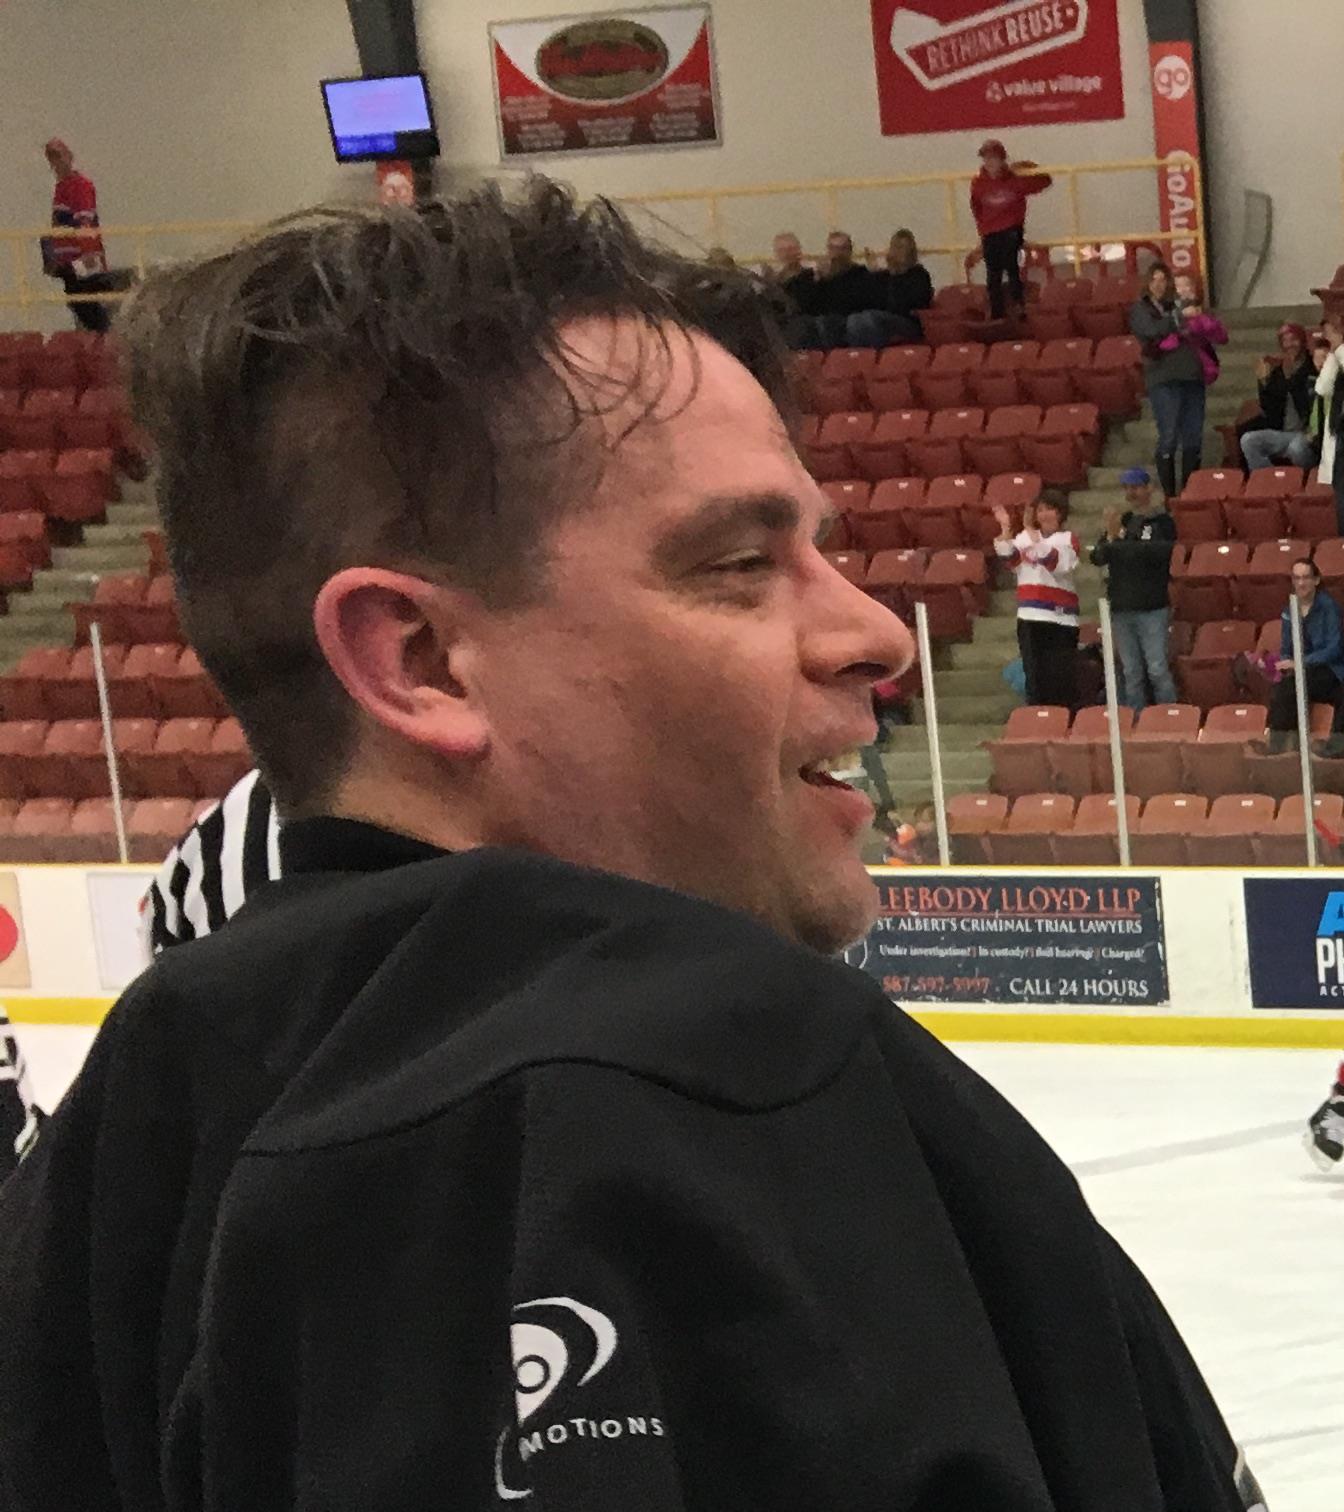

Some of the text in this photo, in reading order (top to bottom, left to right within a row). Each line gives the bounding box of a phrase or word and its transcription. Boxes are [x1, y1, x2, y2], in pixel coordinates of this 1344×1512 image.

[1005, 2, 1064, 46] REUSE
[1001, 886, 1089, 912] LLOYD
[1097, 888, 1141, 912] LLP
[898, 918, 957, 932] ALBERT'S
[960, 918, 1033, 933] CRIMINAL
[1035, 919, 1077, 933] TRIAL
[1079, 920, 1142, 934] LAWYERS
[1009, 977, 1054, 996] CALL
[1058, 978, 1078, 995] 24
[1083, 979, 1149, 997] HOURS
[518, 1416, 665, 1462] MOTIONS
